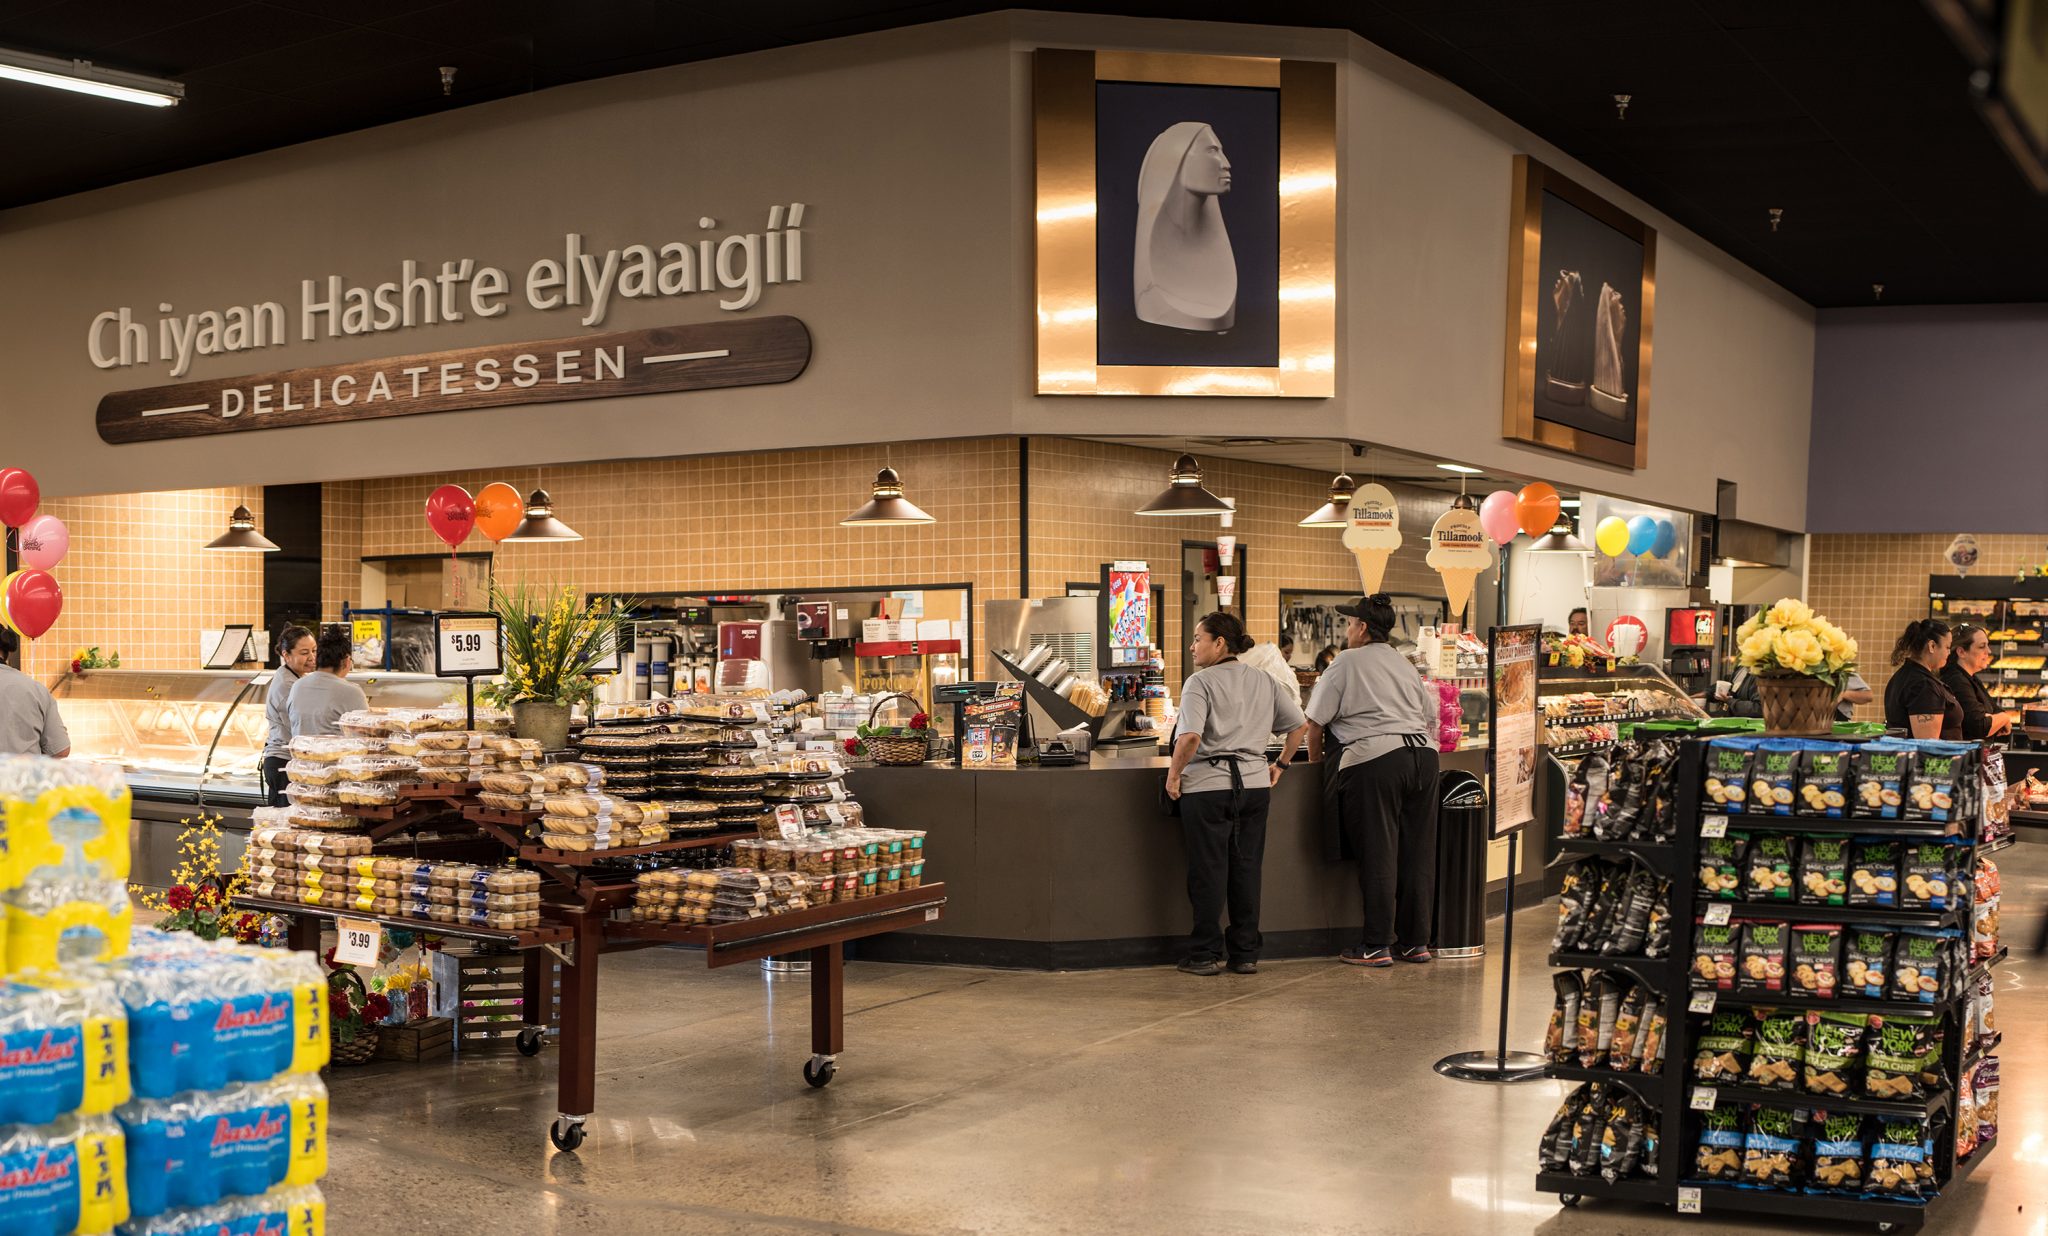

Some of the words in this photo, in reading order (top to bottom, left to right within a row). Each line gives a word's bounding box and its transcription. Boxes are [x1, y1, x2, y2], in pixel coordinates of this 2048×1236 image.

[220, 345, 629, 418] DELICATESSEN
[1353, 507, 1394, 520] Tillamook
[1437, 530, 1484, 542] Tillamook
[451, 634, 481, 652] $5.99
[970, 731, 987, 741] ICEE
[1753, 926, 1780, 935] NEW
[349, 931, 370, 948] $3.99
[1753, 934, 1779, 944] YORK
[1803, 934, 1831, 943] NEW
[1803, 942, 1831, 953] YORK
[1882, 1027, 1917, 1040] NEW
[1882, 1038, 1915, 1052] YORK
